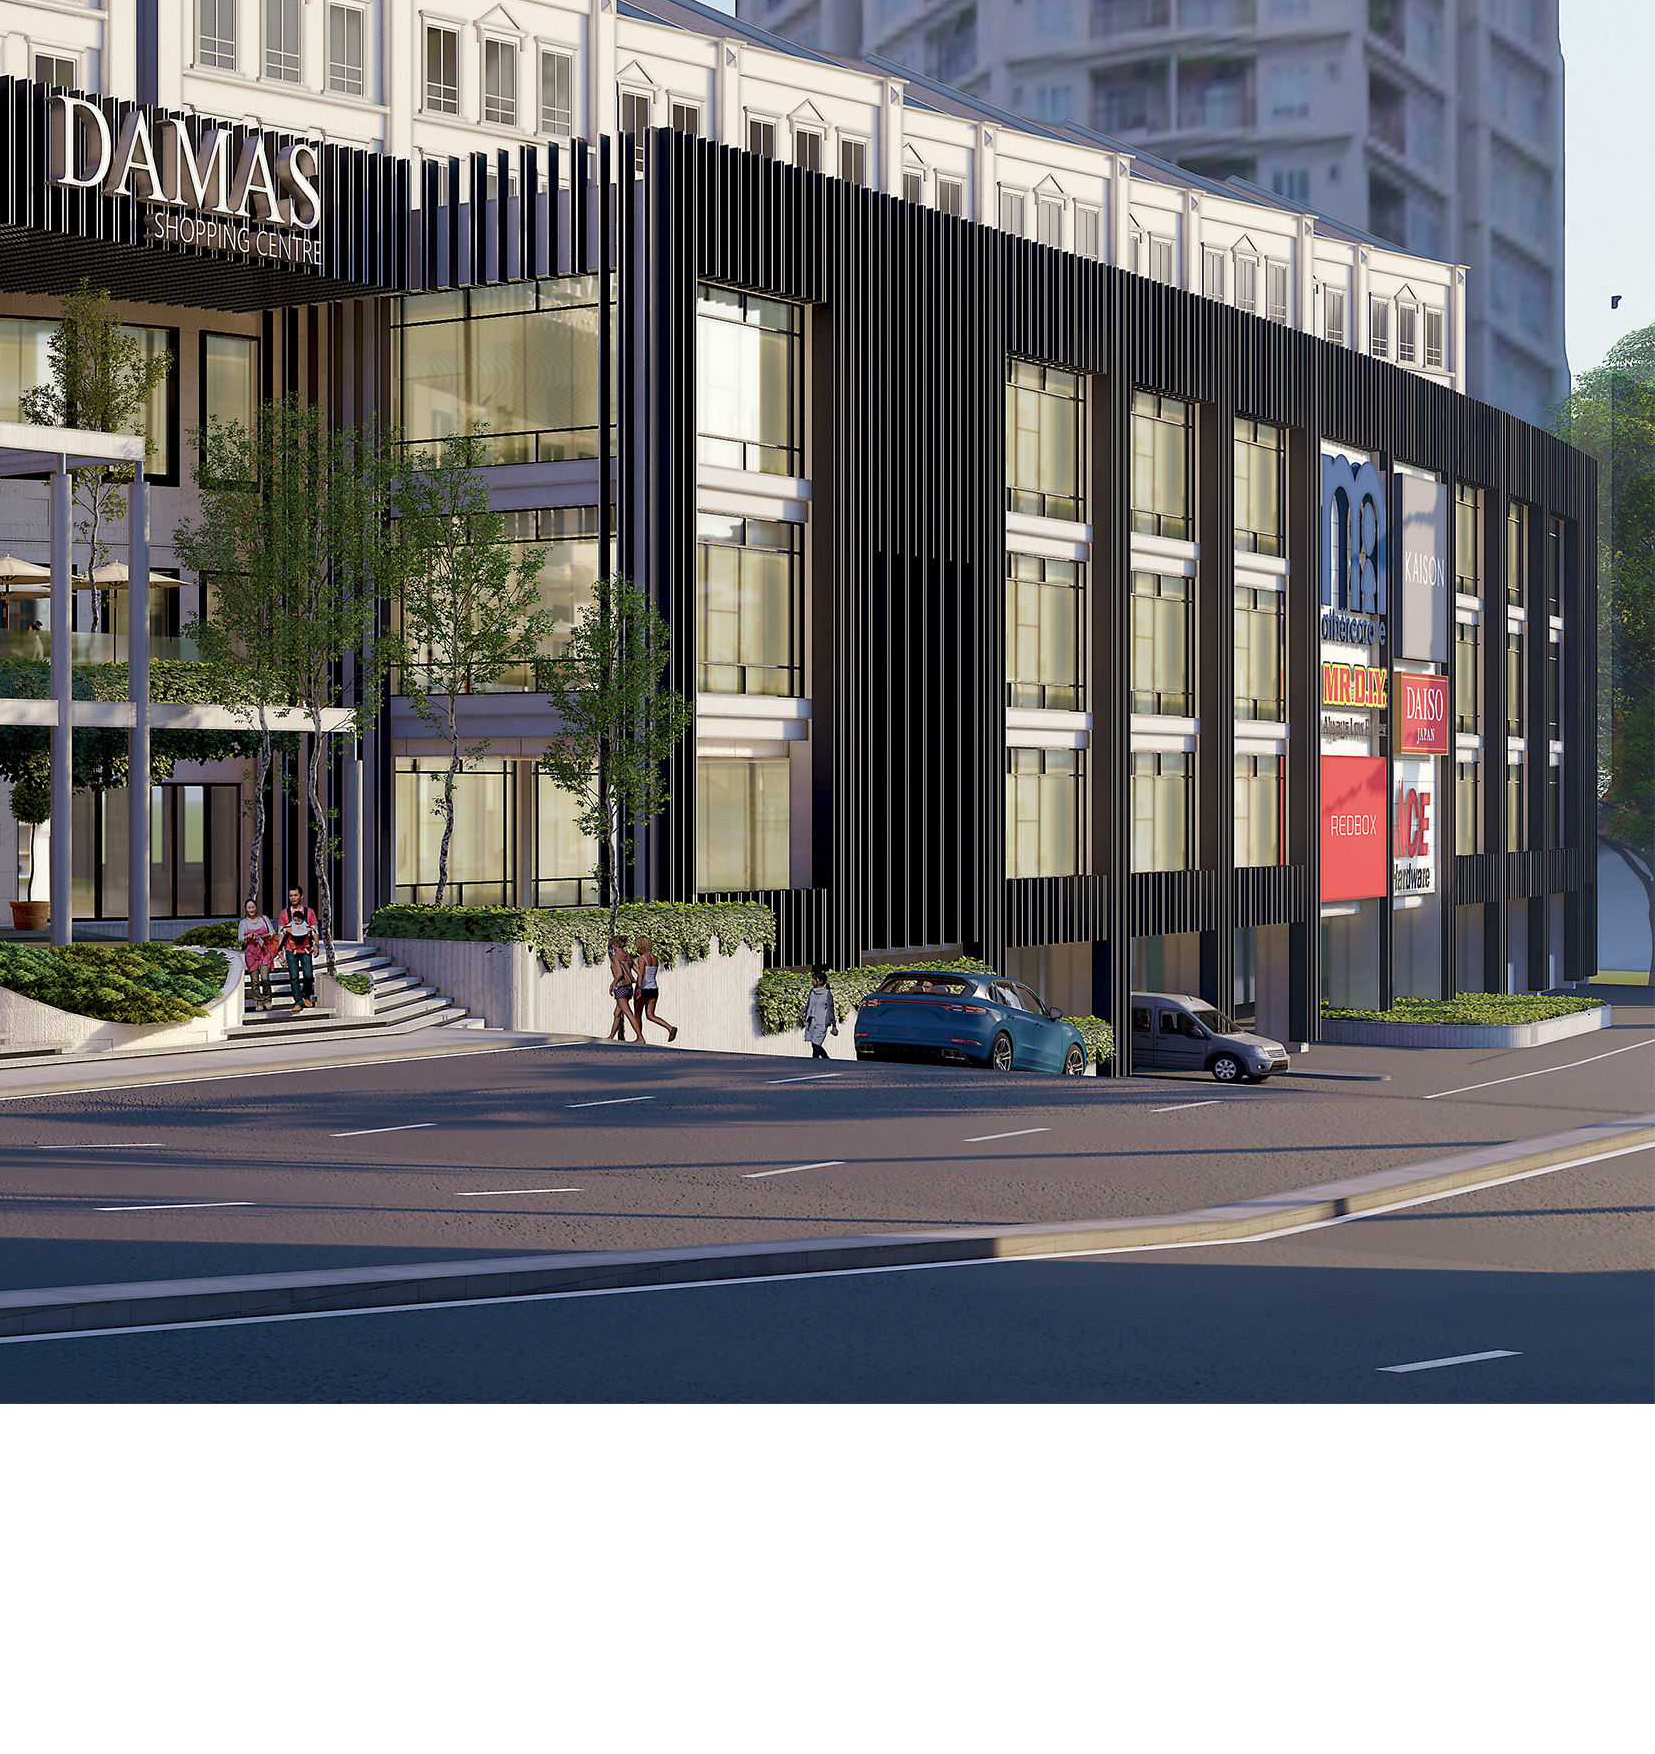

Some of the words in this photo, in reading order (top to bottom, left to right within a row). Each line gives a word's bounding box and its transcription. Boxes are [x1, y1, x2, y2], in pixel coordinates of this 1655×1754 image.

[55, 94, 320, 230] DAMAS
[153, 212, 250, 254] SHOPPING
[255, 230, 322, 266] CENTRE
[1405, 550, 1445, 588] KAISON
[1406, 686, 1444, 721] DAISO
[1416, 727, 1436, 744] JAPAN
[1330, 814, 1377, 836] REDBOX
[1393, 777, 1431, 858] ACE
[1393, 863, 1430, 891] Hardware
